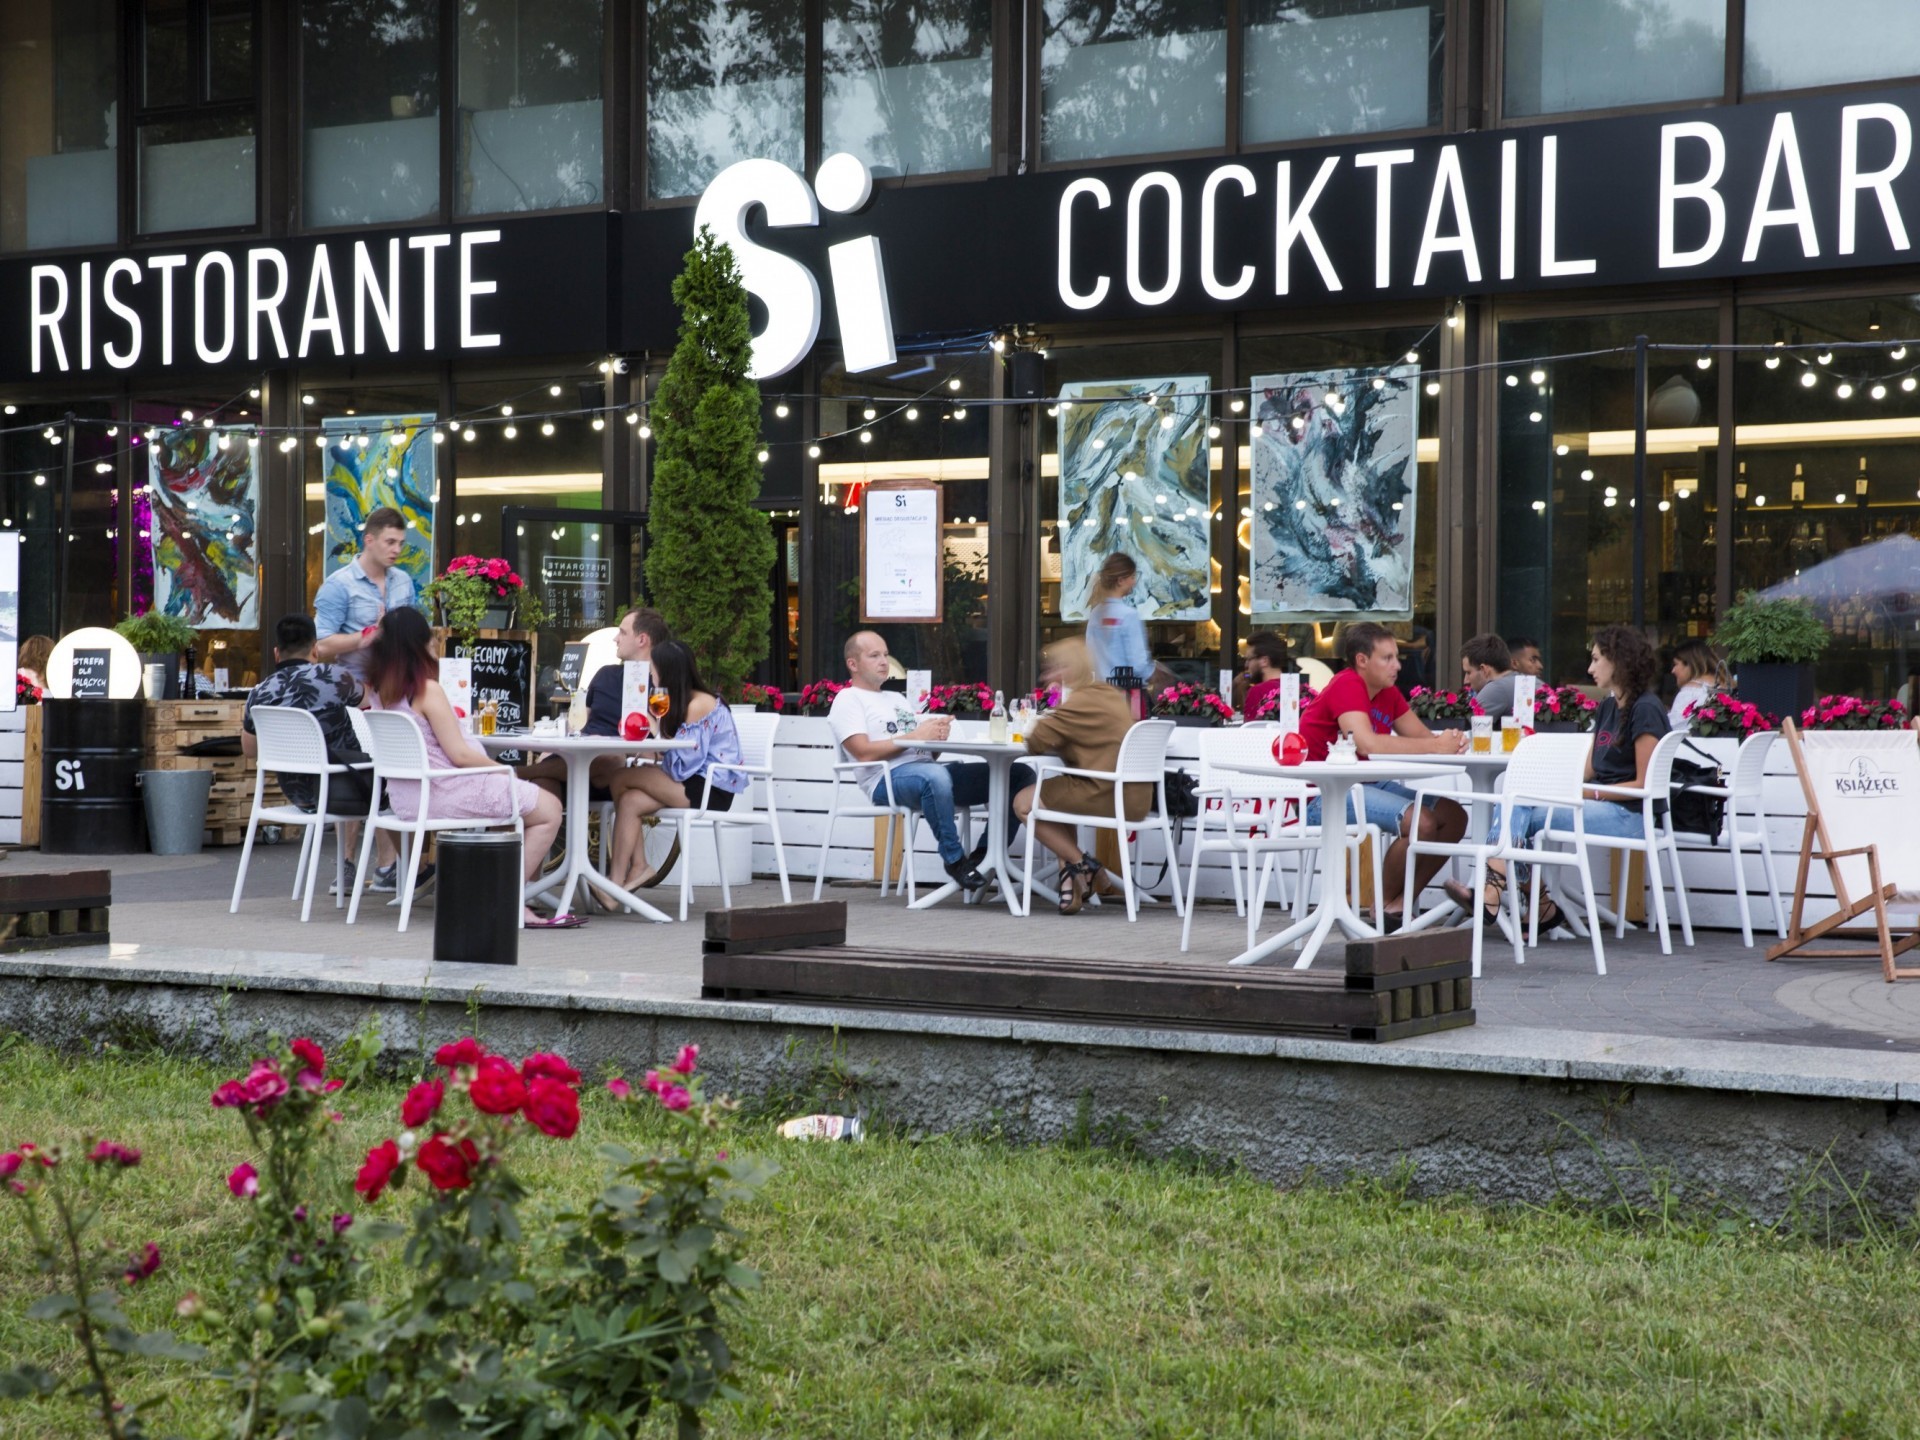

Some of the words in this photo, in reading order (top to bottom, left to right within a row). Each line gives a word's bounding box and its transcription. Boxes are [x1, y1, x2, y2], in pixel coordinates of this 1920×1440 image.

[1057, 134, 1597, 311] COCKTAIL
[1657, 102, 1911, 269] BAR
[693, 152, 898, 380] Si
[30, 229, 502, 373] RISTORANTE
[895, 494, 907, 507] Si
[73, 657, 104, 666] STREFA
[78, 667, 92, 675] DLA
[55, 759, 85, 790] Si
[1835, 777, 1899, 794] KSIĄŻĘCE
